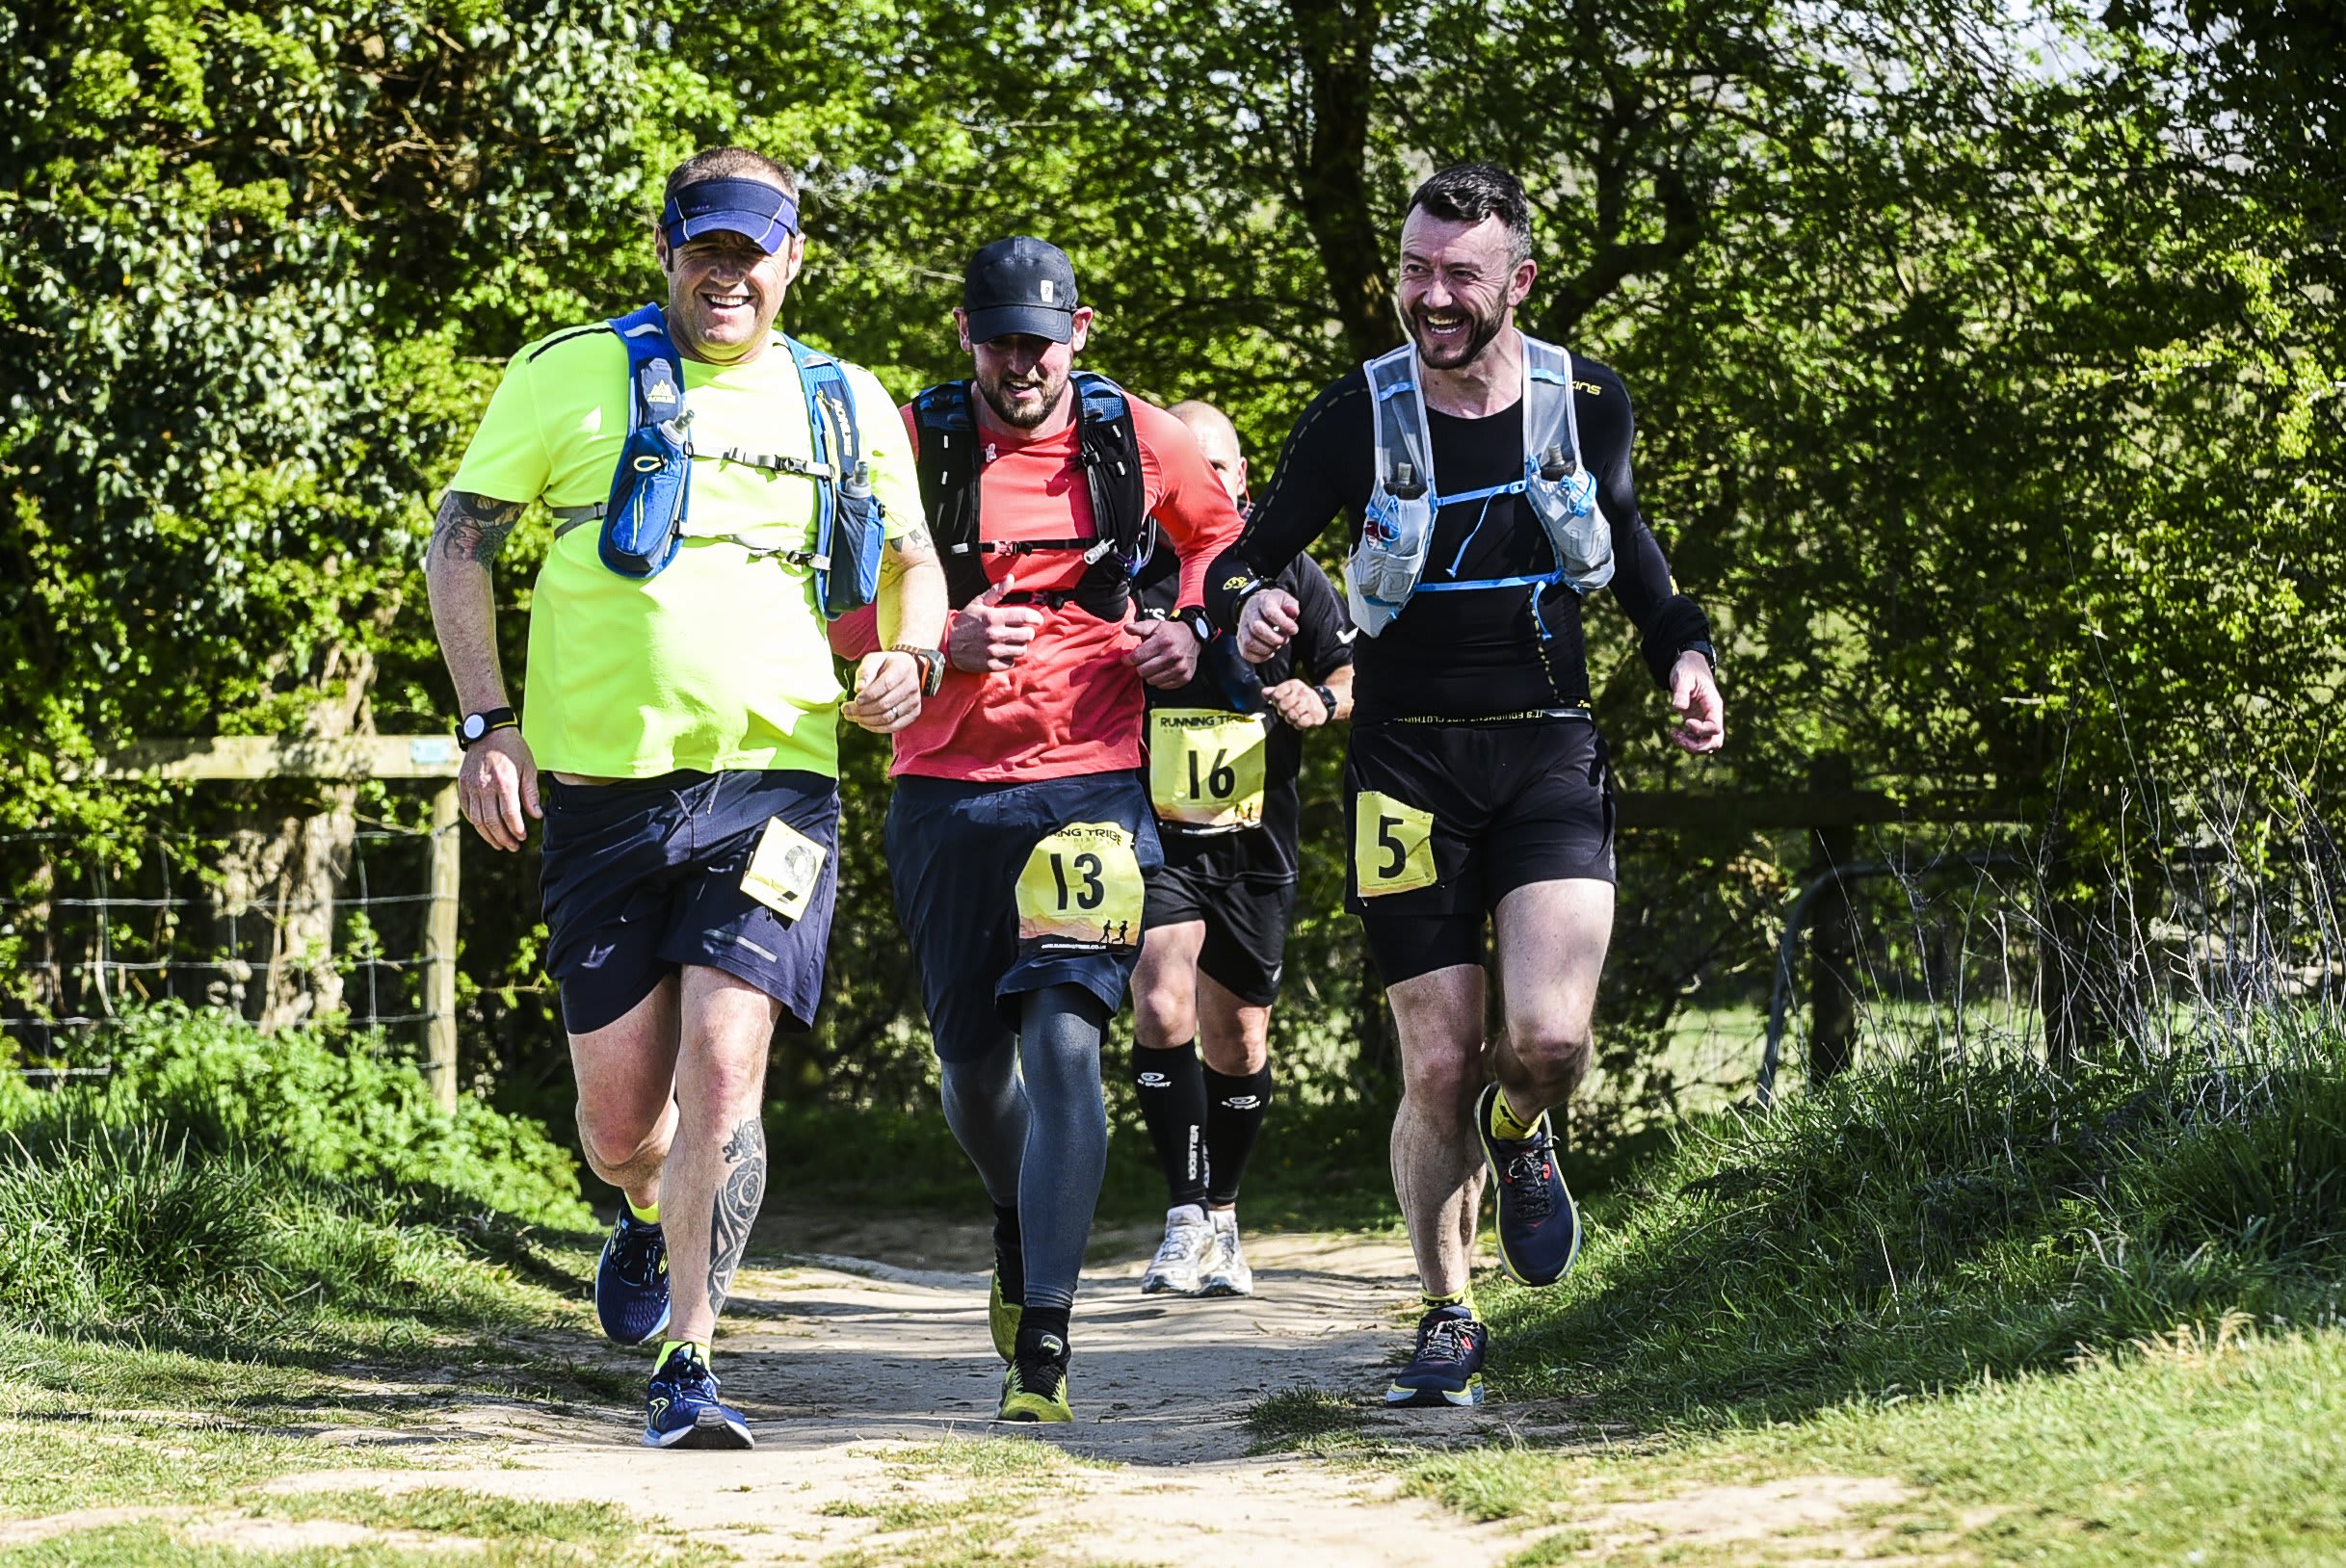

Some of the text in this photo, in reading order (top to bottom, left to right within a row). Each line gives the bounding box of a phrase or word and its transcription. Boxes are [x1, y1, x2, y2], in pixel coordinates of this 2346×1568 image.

[1160, 716, 1214, 727] RUNNING
[1188, 748, 1235, 799] 16
[1085, 828, 1122, 847] TRIBE
[1379, 815, 1407, 878] 5
[1050, 853, 1104, 910] 13
